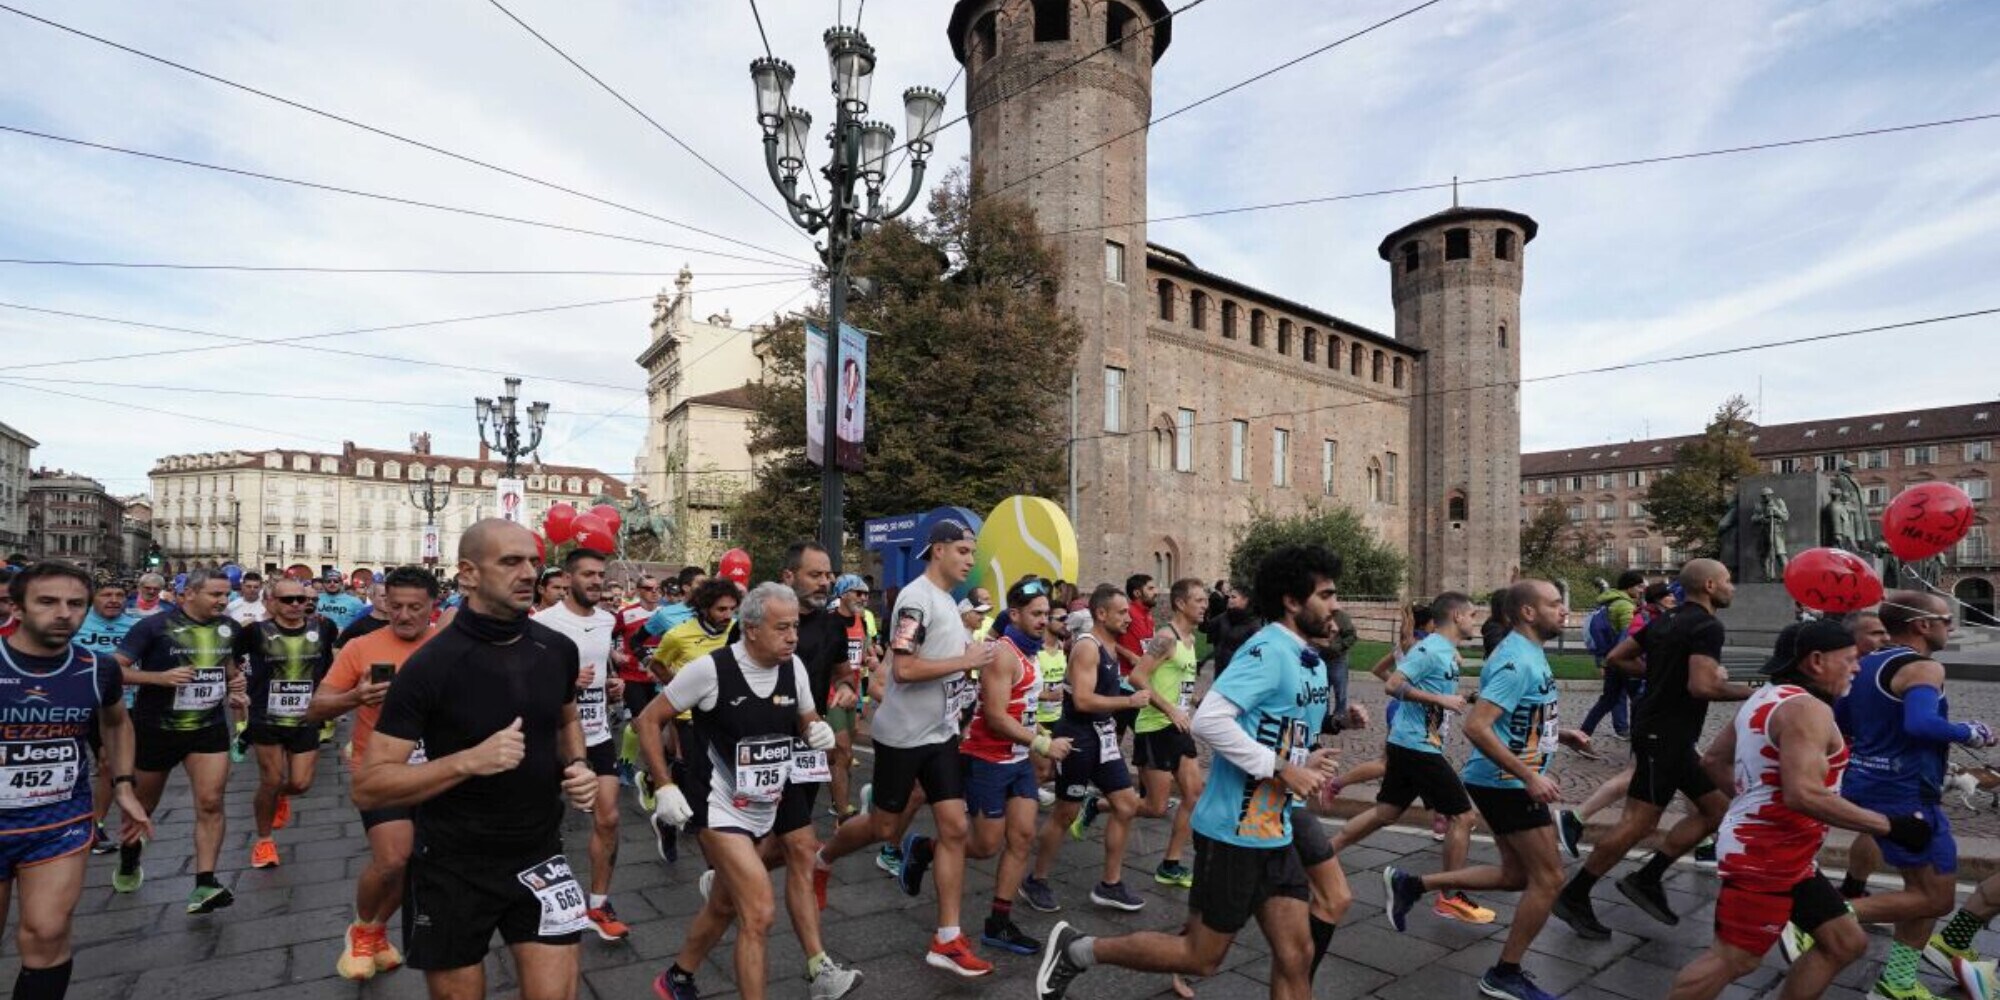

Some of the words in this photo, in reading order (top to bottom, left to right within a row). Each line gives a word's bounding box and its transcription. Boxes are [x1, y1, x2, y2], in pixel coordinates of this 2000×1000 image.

[317, 603, 347, 616] Jeep
[193, 687, 212, 698] 167
[281, 682, 309, 694] Jeep
[280, 696, 301, 706] 682
[13, 744, 73, 761] Jeep
[753, 745, 789, 761] Jeep
[10, 769, 53, 789] 452
[754, 769, 779, 787] 735
[555, 886, 582, 911] 663
